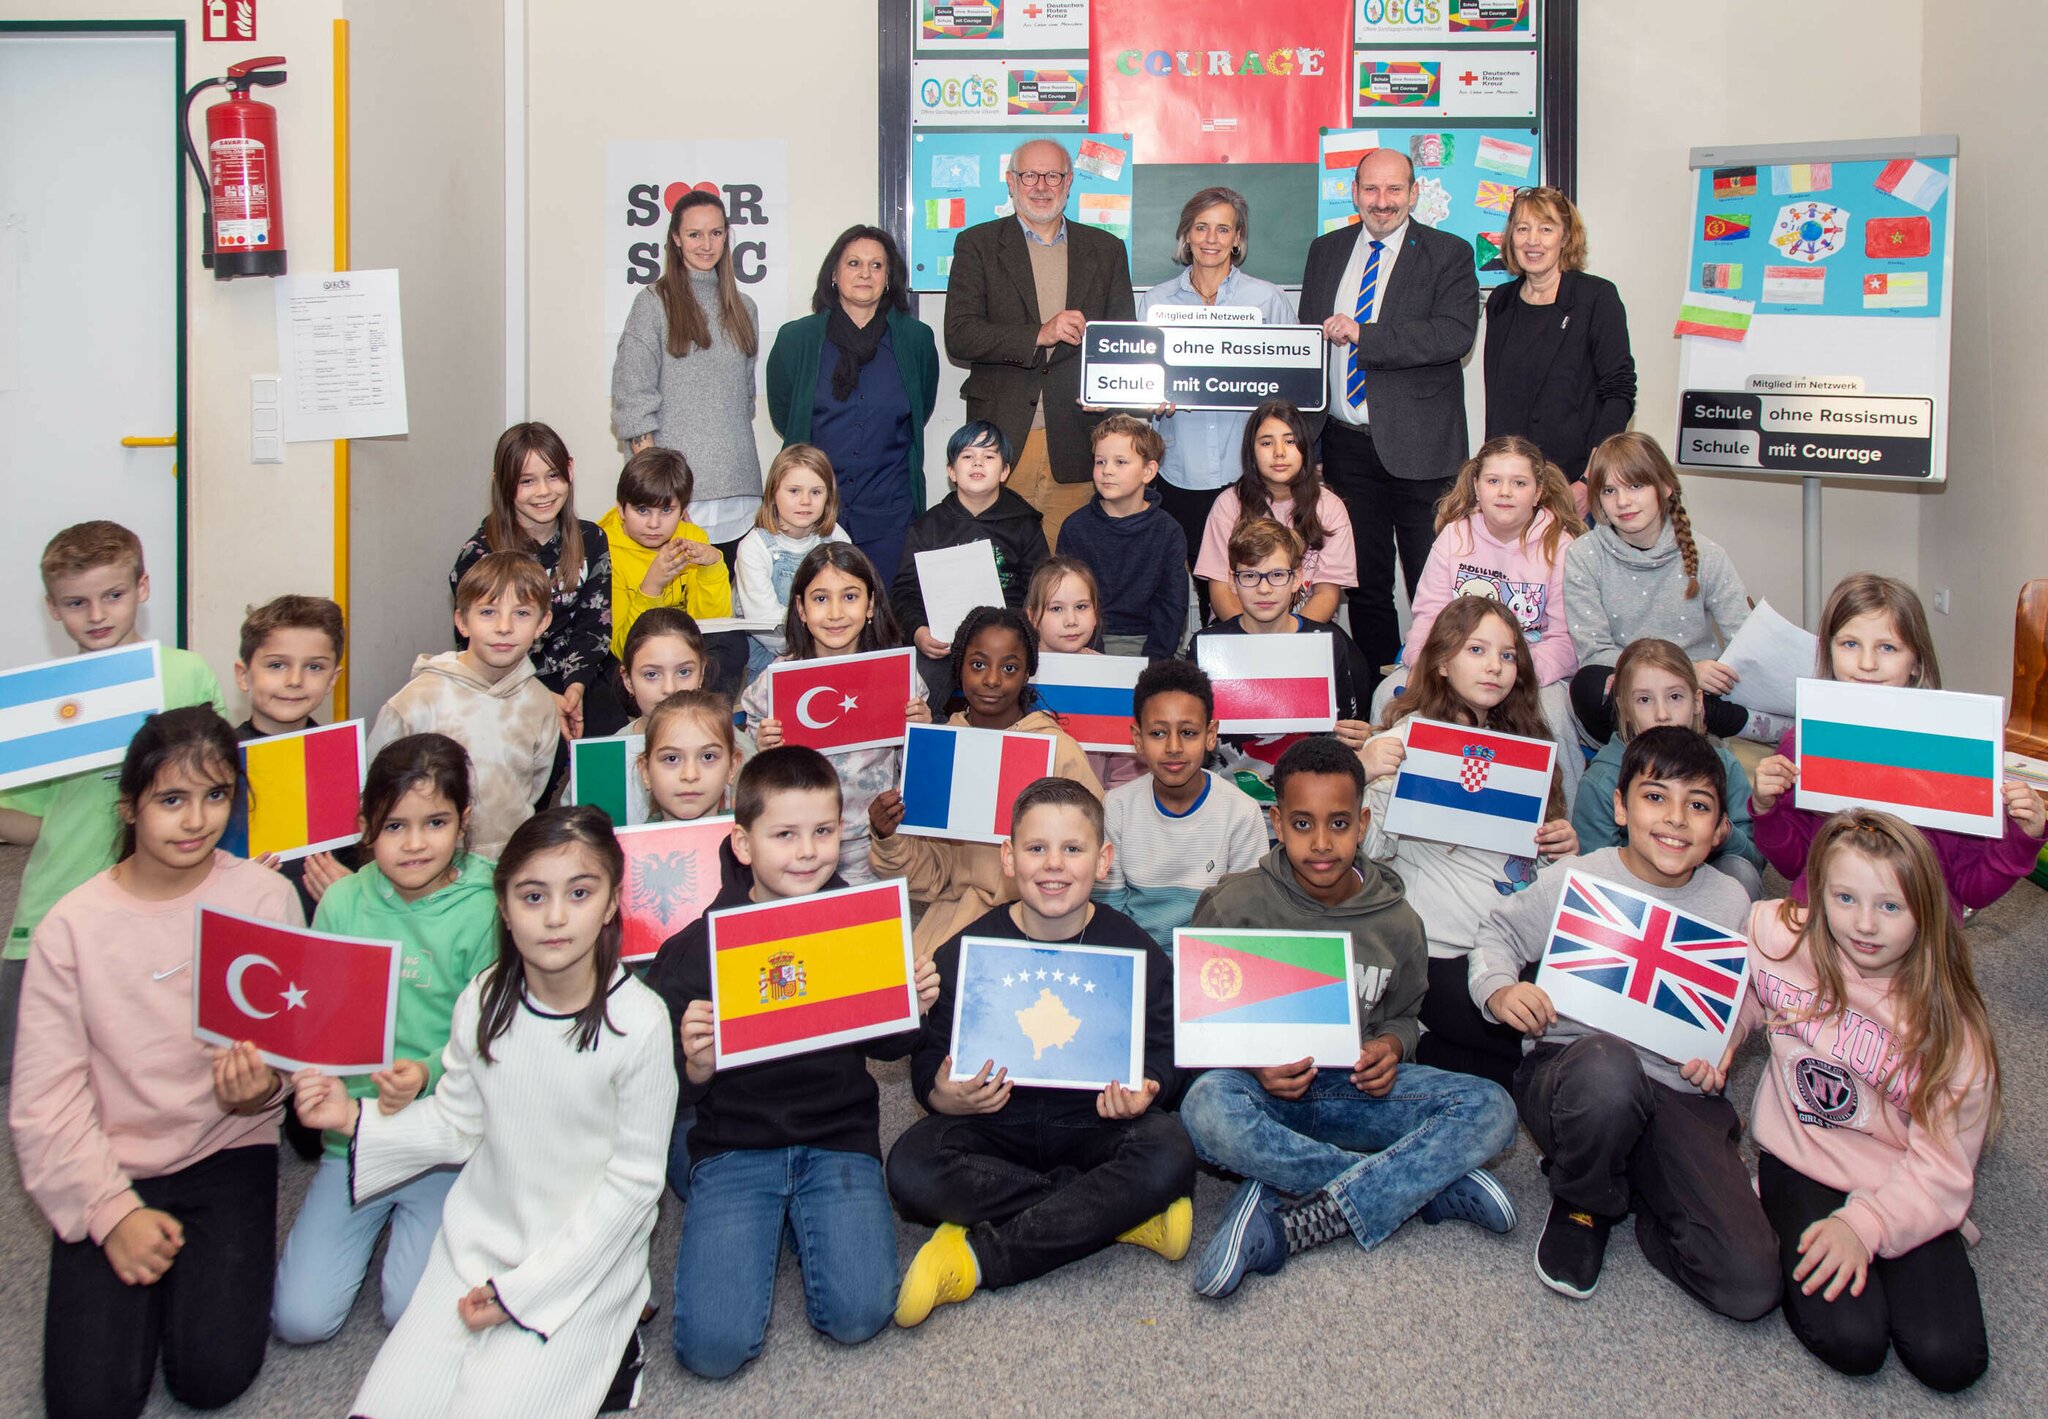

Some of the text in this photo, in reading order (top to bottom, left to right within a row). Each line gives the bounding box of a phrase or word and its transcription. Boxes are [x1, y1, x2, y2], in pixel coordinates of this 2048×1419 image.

[1116, 47, 1325, 76] COURAGE
[921, 78, 999, 108] OGGS
[627, 241, 768, 284] SC
[1156, 311, 1255, 322] Mitglied im Netzwerk
[1099, 338, 1311, 356] Schule ohne Rassismus
[1098, 376, 1280, 396] Schule mit Courage
[1752, 379, 1857, 390] Mitglied im Netzwerk
[1694, 405, 1918, 426] Schule ohne Rassismus
[1692, 439, 1882, 463] Schule mit Courage
[1757, 969, 1834, 1047] NEW
[1812, 1070, 1842, 1107] NY
[1799, 1113, 1823, 1126] GIRLS
